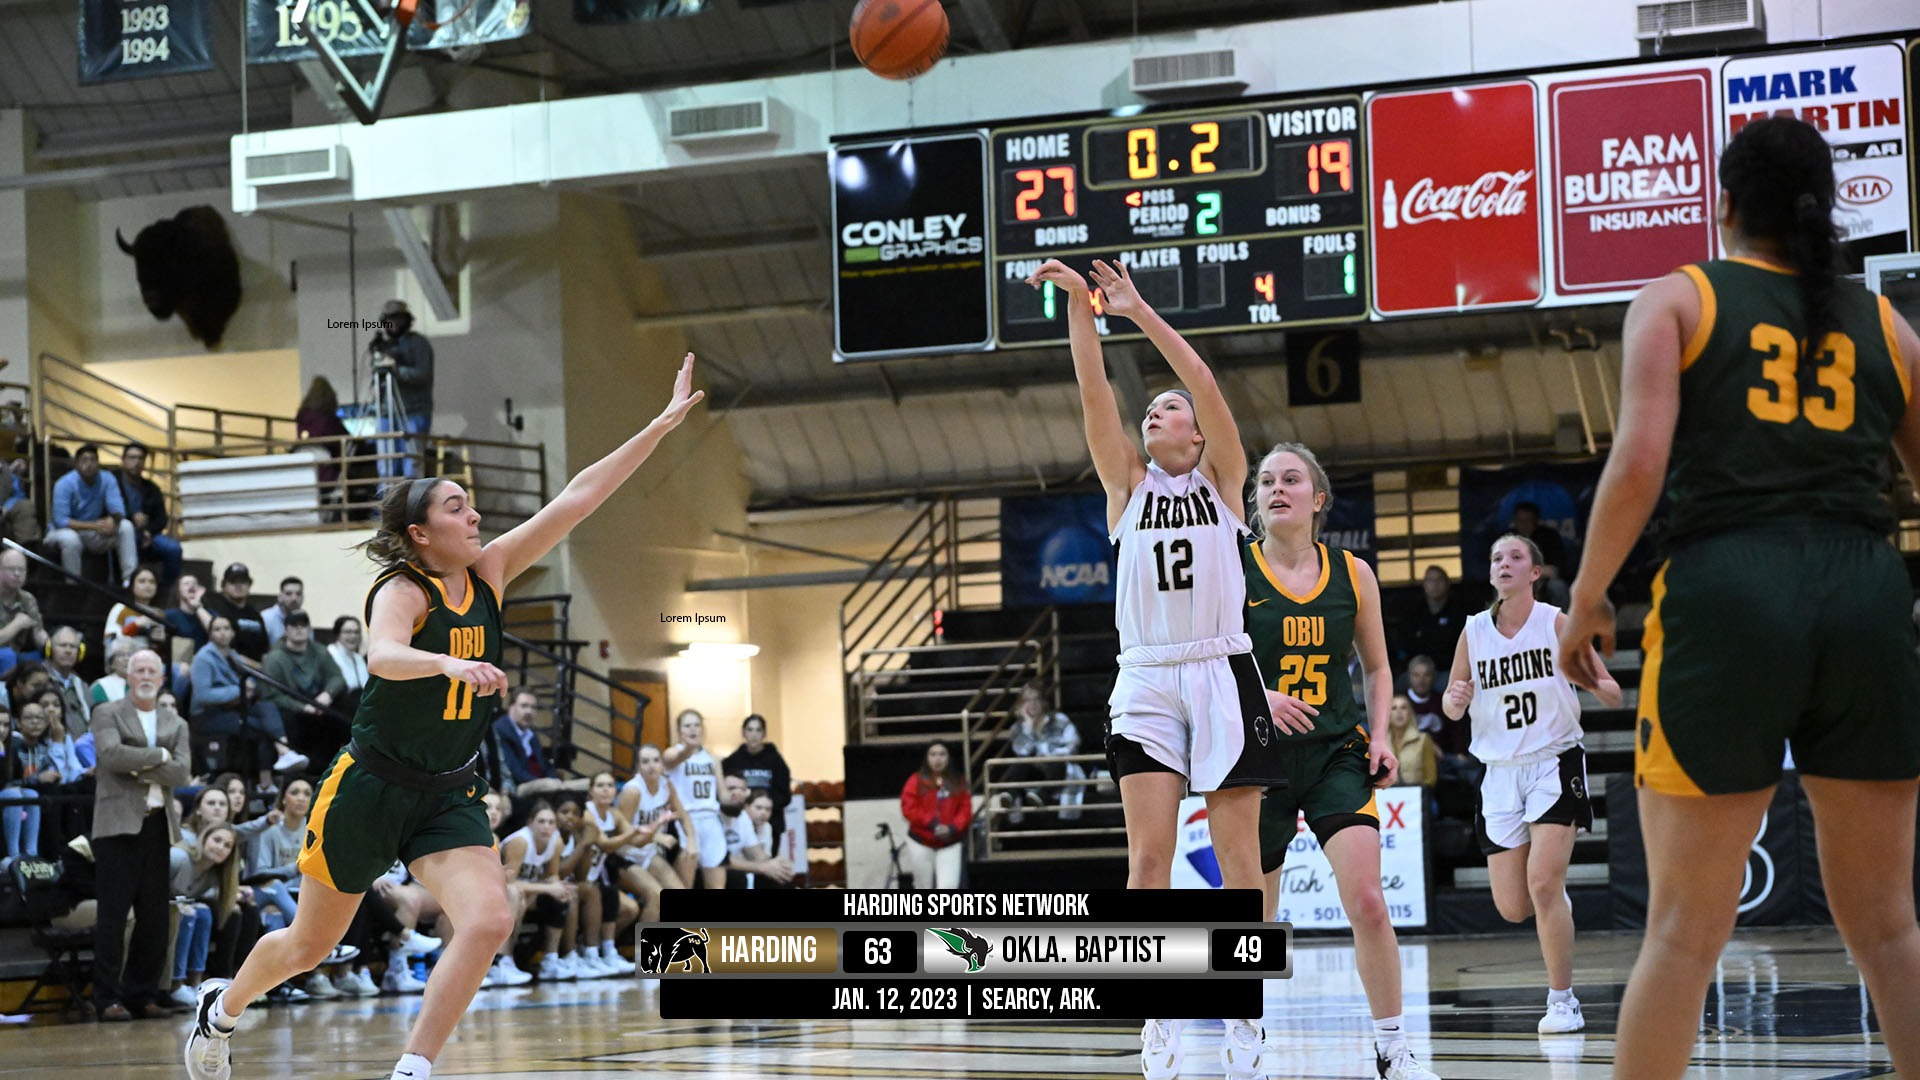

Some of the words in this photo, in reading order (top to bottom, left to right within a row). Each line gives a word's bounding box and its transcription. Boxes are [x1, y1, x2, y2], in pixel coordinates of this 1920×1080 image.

[120, 5, 169, 33] 1993
[121, 38, 171, 65] 1994
[1728, 66, 1858, 104] MARK
[1267, 106, 1357, 137] VISITOR
[1006, 133, 1070, 162] HOME
[1128, 122, 1219, 180] 0.2
[1602, 132, 1698, 168] FARM
[1307, 141, 1351, 194] 19
[1565, 163, 1701, 205] BUREAU
[1016, 166, 1075, 221] 27
[1142, 188, 1175, 205] POSS
[1401, 169, 1534, 224] Coca-Cola
[1847, 182, 1884, 198] KIA
[842, 213, 967, 247] CONLEY
[1129, 203, 1189, 226] PERIOD
[1196, 192, 1221, 234] 2
[1266, 204, 1321, 226] BONUS
[879, 236, 983, 261] GRAPHICS
[1035, 224, 1088, 246] BONUS
[1197, 241, 1249, 263] FOULS
[1303, 232, 1356, 254] FOULS
[1120, 247, 1180, 269] PLAYER
[1343, 253, 1356, 295] 1
[1044, 280, 1054, 319] 1
[1254, 273, 1274, 303] 4
[1248, 304, 1281, 324] TOL
[1306, 336, 1341, 398] 6
[1747, 322, 1855, 431] 33
[1135, 486, 1219, 531] ARDING
[1041, 561, 1110, 588] NCAA
[1153, 538, 1193, 591] 12
[450, 625, 485, 659] OBU
[1283, 616, 1325, 647] OBU
[1278, 654, 1330, 705] 25
[1477, 647, 1554, 690] HARDING
[443, 679, 473, 720] 11
[1504, 691, 1536, 729] 20
